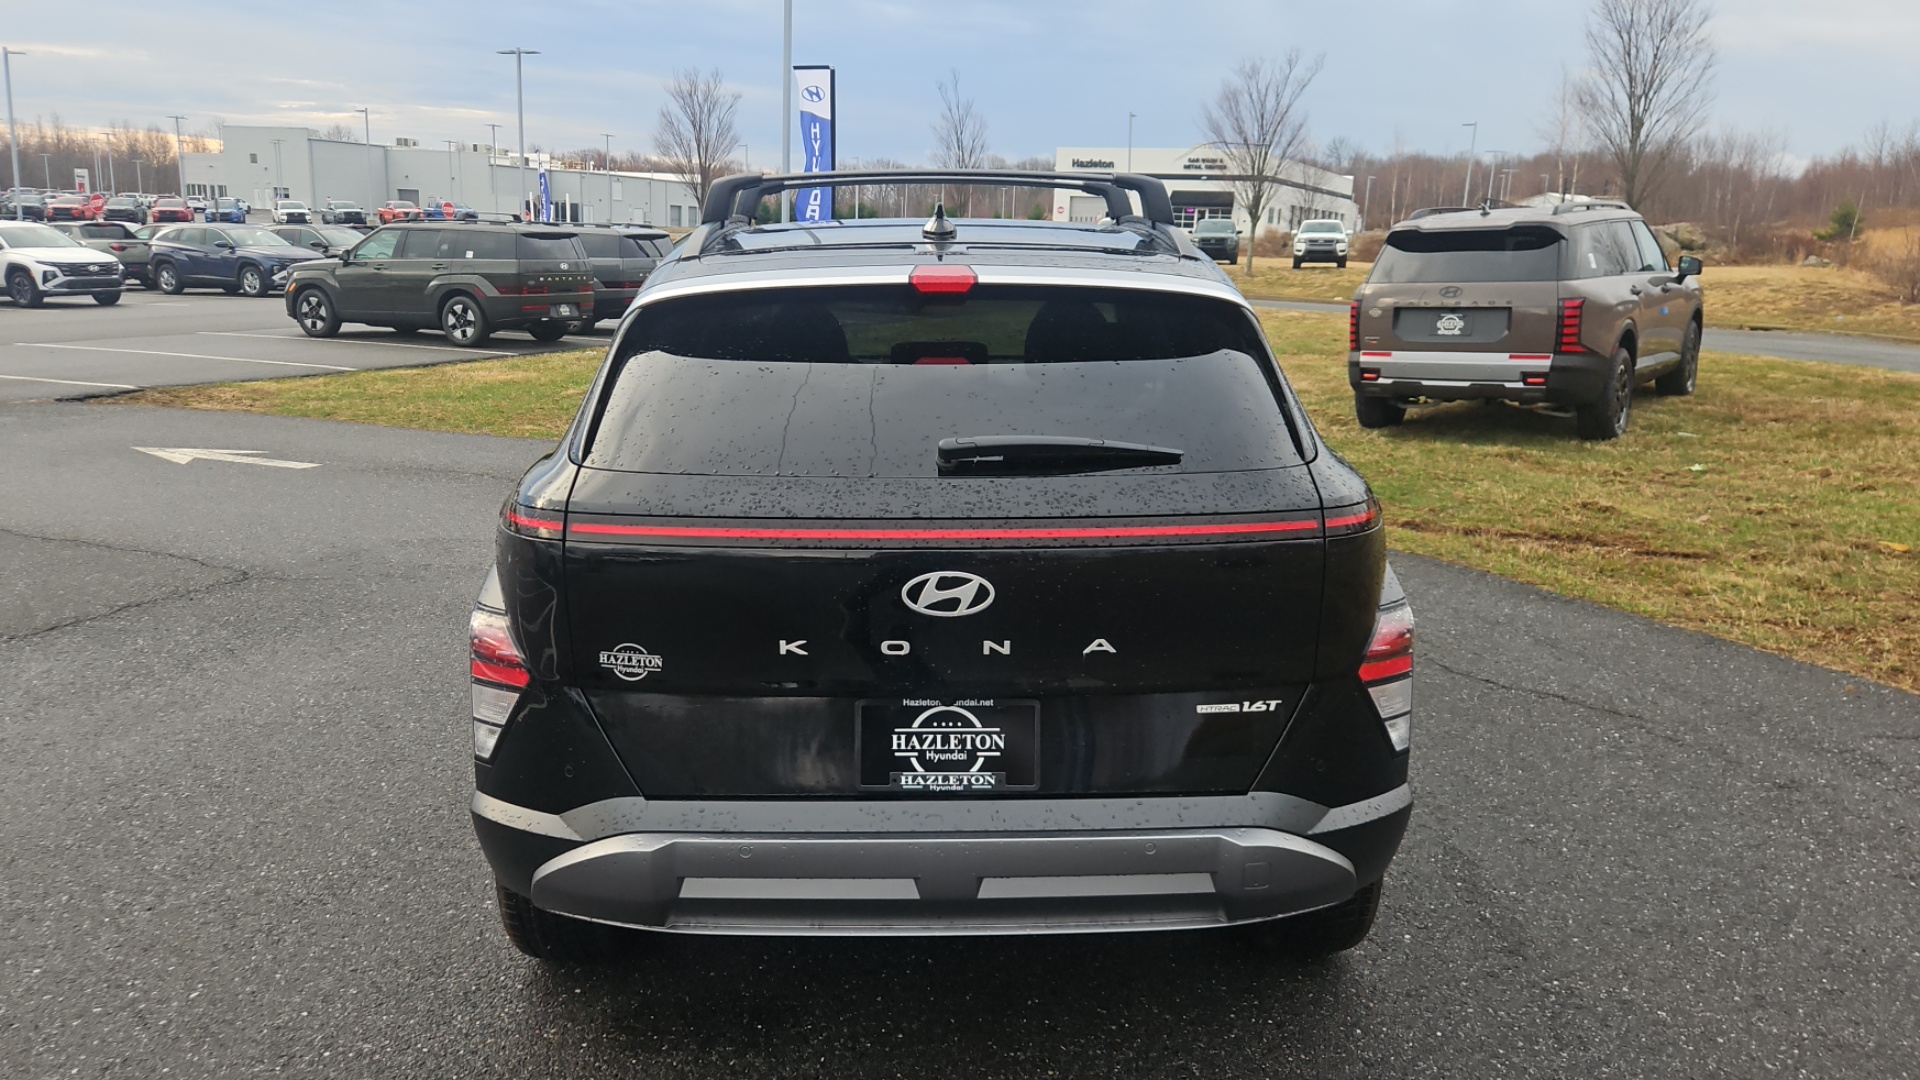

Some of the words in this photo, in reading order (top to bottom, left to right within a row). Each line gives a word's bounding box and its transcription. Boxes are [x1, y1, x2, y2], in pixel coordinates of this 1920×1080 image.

[1071, 158, 1115, 168] Hazleton
[779, 639, 1117, 656] KONA
[599, 653, 663, 668] HAZLETON
[617, 665, 644, 674] Hyundai
[891, 734, 1006, 750] HAZLETON
[926, 750, 968, 763] Hyundai
[900, 775, 996, 785] HAZLETON
[929, 784, 964, 792] Hyundai
